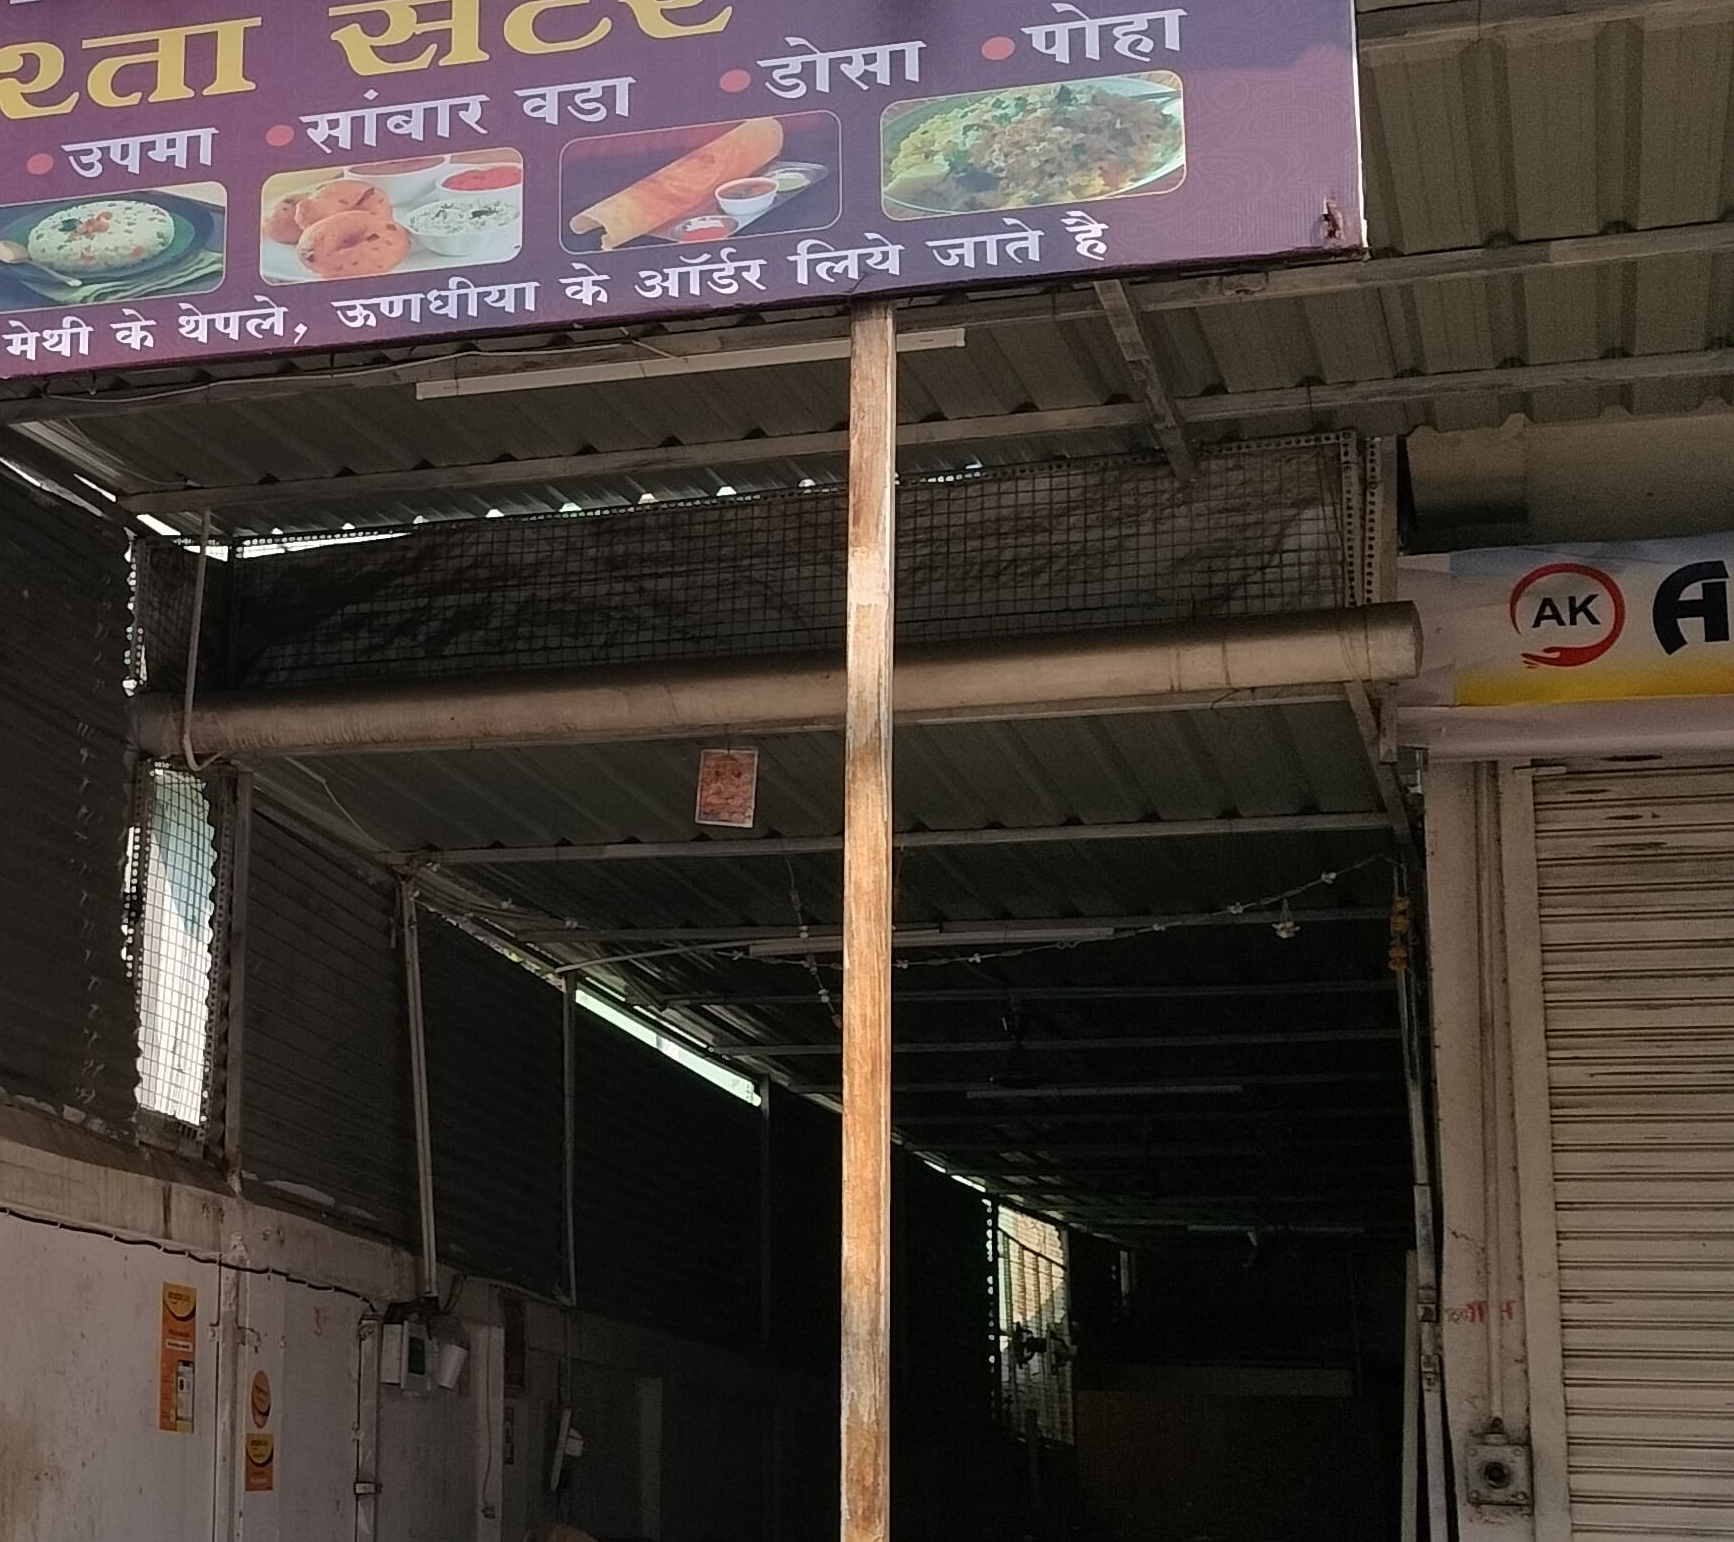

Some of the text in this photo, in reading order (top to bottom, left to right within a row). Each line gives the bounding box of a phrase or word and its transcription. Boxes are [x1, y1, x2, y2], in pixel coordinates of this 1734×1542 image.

[62, 127, 218, 179] उपमा
[300, 91, 491, 155] सांबार
[514, 76, 637, 129] वडा
[757, 35, 928, 101] डोसा
[1021, 2, 1188, 67] पोहा
[3, 315, 93, 362] मेथी
[109, 308, 158, 350] के
[178, 295, 308, 347] थेपले,
[558, 262, 611, 308] के
[635, 247, 767, 303] ऑर्डर
[787, 233, 905, 286] लिये
[925, 217, 1046, 269] जाते
[1060, 210, 1110, 261] है
[1531, 593, 1602, 629] AK
